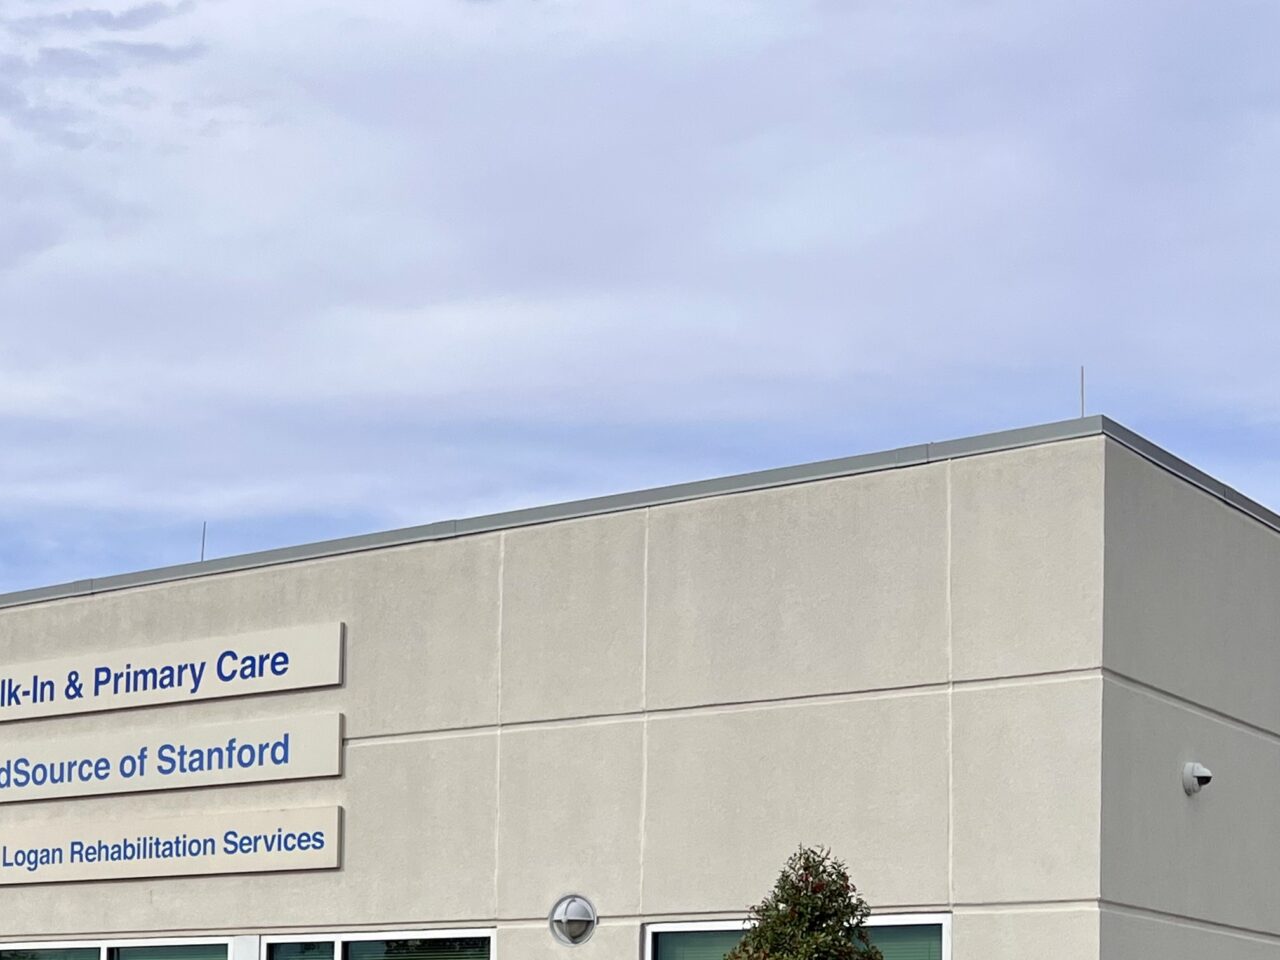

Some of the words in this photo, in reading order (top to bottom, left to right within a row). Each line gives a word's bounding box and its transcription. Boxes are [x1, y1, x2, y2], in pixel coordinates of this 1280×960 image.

[64, 670, 84, 699] &
[93, 659, 207, 697] Primary
[216, 650, 290, 682] Care
[119, 747, 149, 778] of
[157, 733, 290, 774] Stanford
[2, 846, 64, 872] Logan
[70, 834, 216, 864] Rehabilitation
[223, 828, 326, 855] Services
